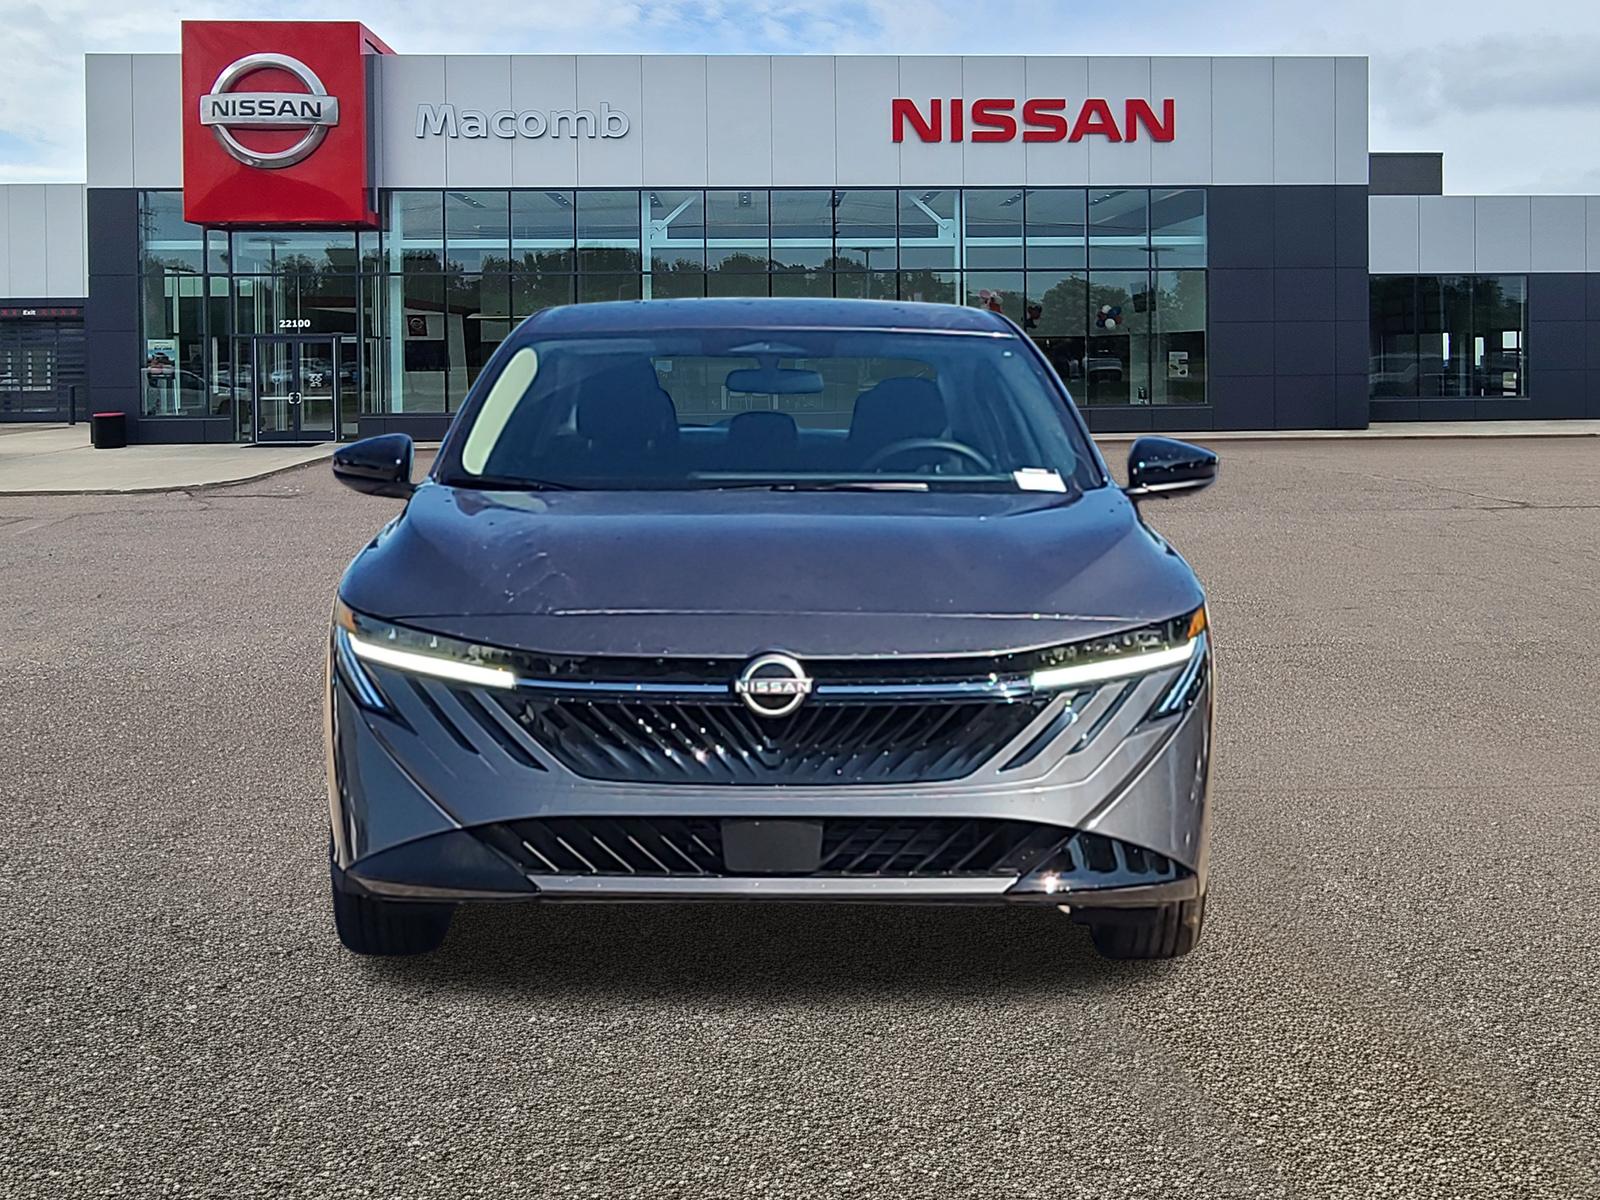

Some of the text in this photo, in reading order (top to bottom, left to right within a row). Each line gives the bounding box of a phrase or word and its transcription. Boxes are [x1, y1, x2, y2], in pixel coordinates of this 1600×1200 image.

[211, 100, 322, 118] NISSAN
[415, 102, 630, 138] Macomb
[892, 98, 1175, 142] NISSAN
[279, 319, 311, 328] 22100
[735, 680, 812, 693] NISSAN
